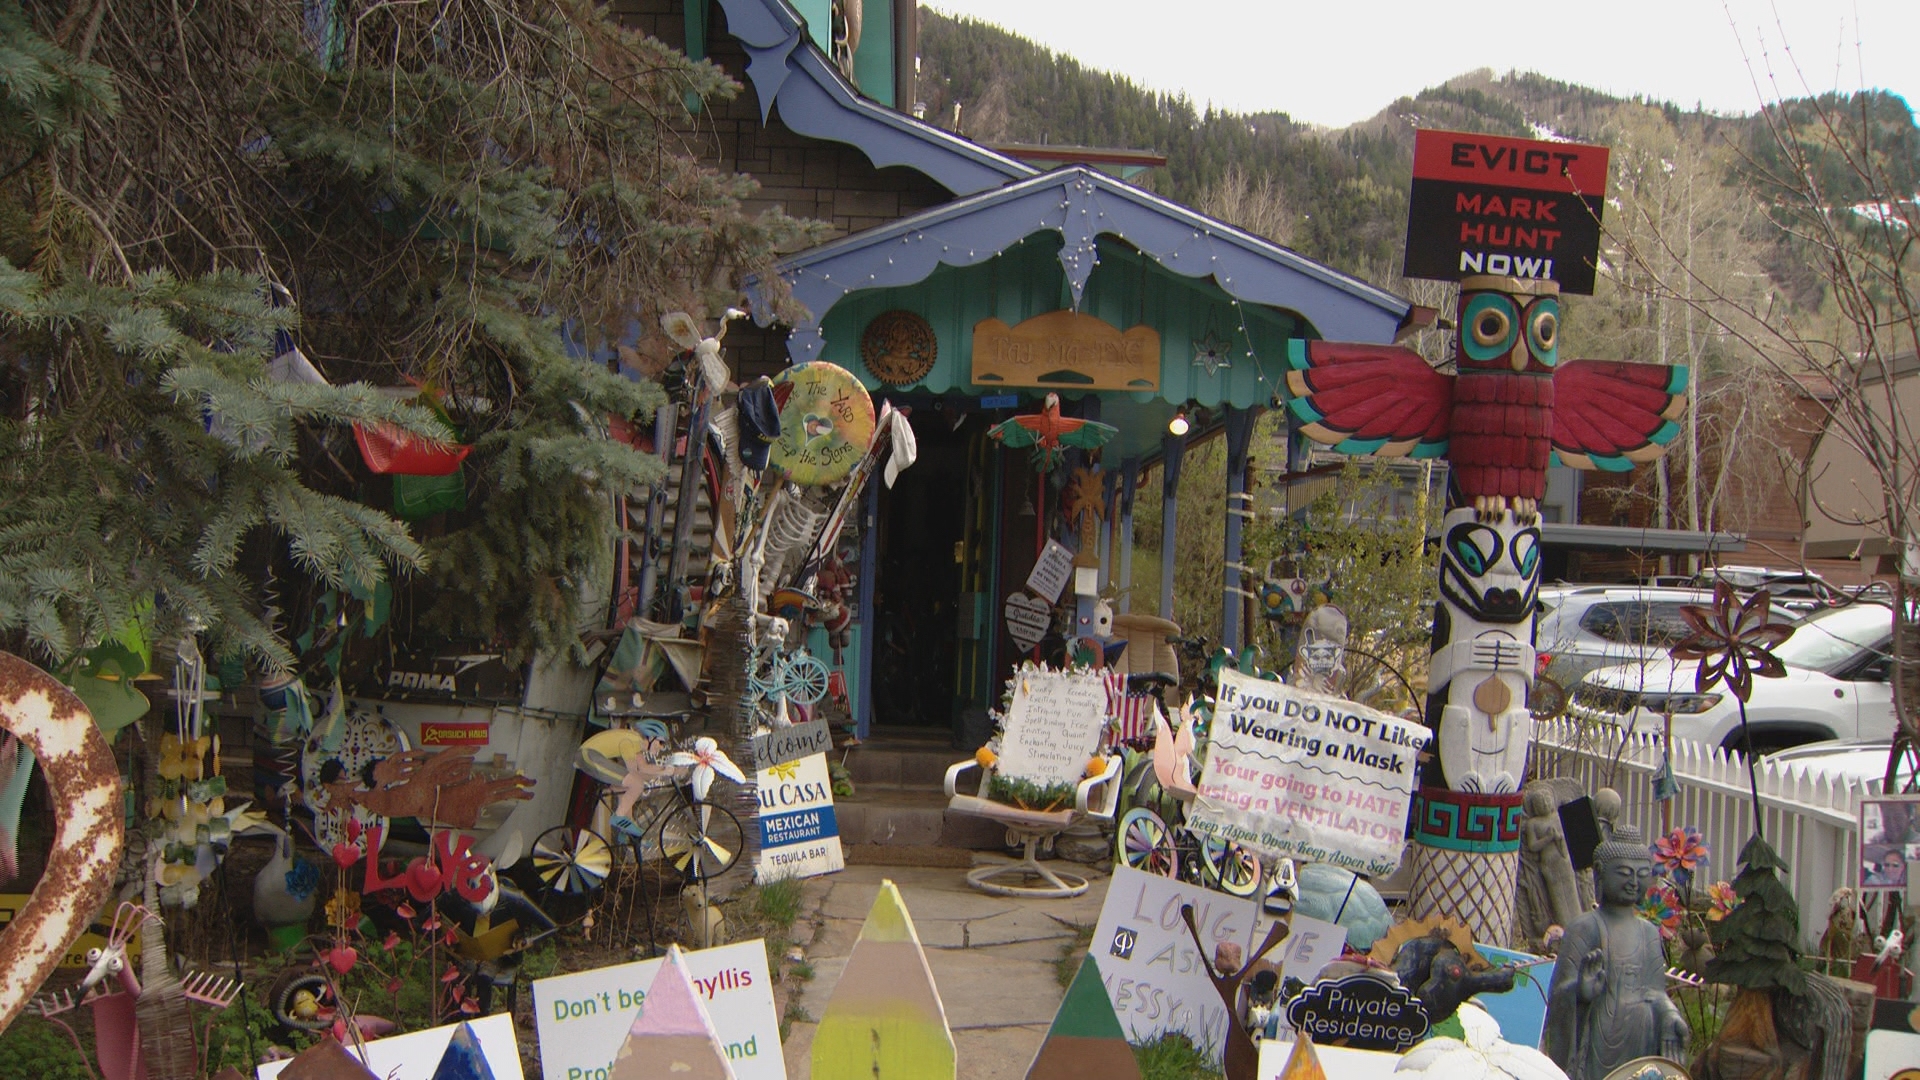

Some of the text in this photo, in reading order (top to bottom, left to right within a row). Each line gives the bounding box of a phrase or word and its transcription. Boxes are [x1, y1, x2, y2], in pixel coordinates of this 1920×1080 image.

[1451, 143, 1578, 177] EVICT
[1456, 192, 1558, 222] MARK
[1460, 222, 1561, 250] HUNT
[1459, 251, 1553, 280] NOW!
[806, 381, 827, 396] The
[800, 449, 817, 466] the
[821, 441, 853, 466] Signs
[1219, 683, 1423, 750] If you DO NOT Like
[758, 729, 827, 765] elcome
[1230, 714, 1404, 774] Wearing a Mask
[1214, 756, 1401, 818] Your going to HATE
[765, 811, 820, 833] MEXICAN
[1200, 783, 1402, 844] using a VENTILATOR
[768, 826, 821, 844] RESTAURANT
[1190, 815, 1218, 834] Keep
[1222, 823, 1258, 844] Aspen
[1296, 842, 1326, 861] Keep
[1328, 849, 1364, 869] Aspen
[1366, 857, 1395, 875] Safe
[770, 847, 826, 866] TEQUILA BAR
[1133, 883, 1237, 941] LONG
[554, 967, 752, 1021] Don't be hyllis
[1328, 989, 1400, 1017] Private
[1303, 1010, 1412, 1041] Residence
